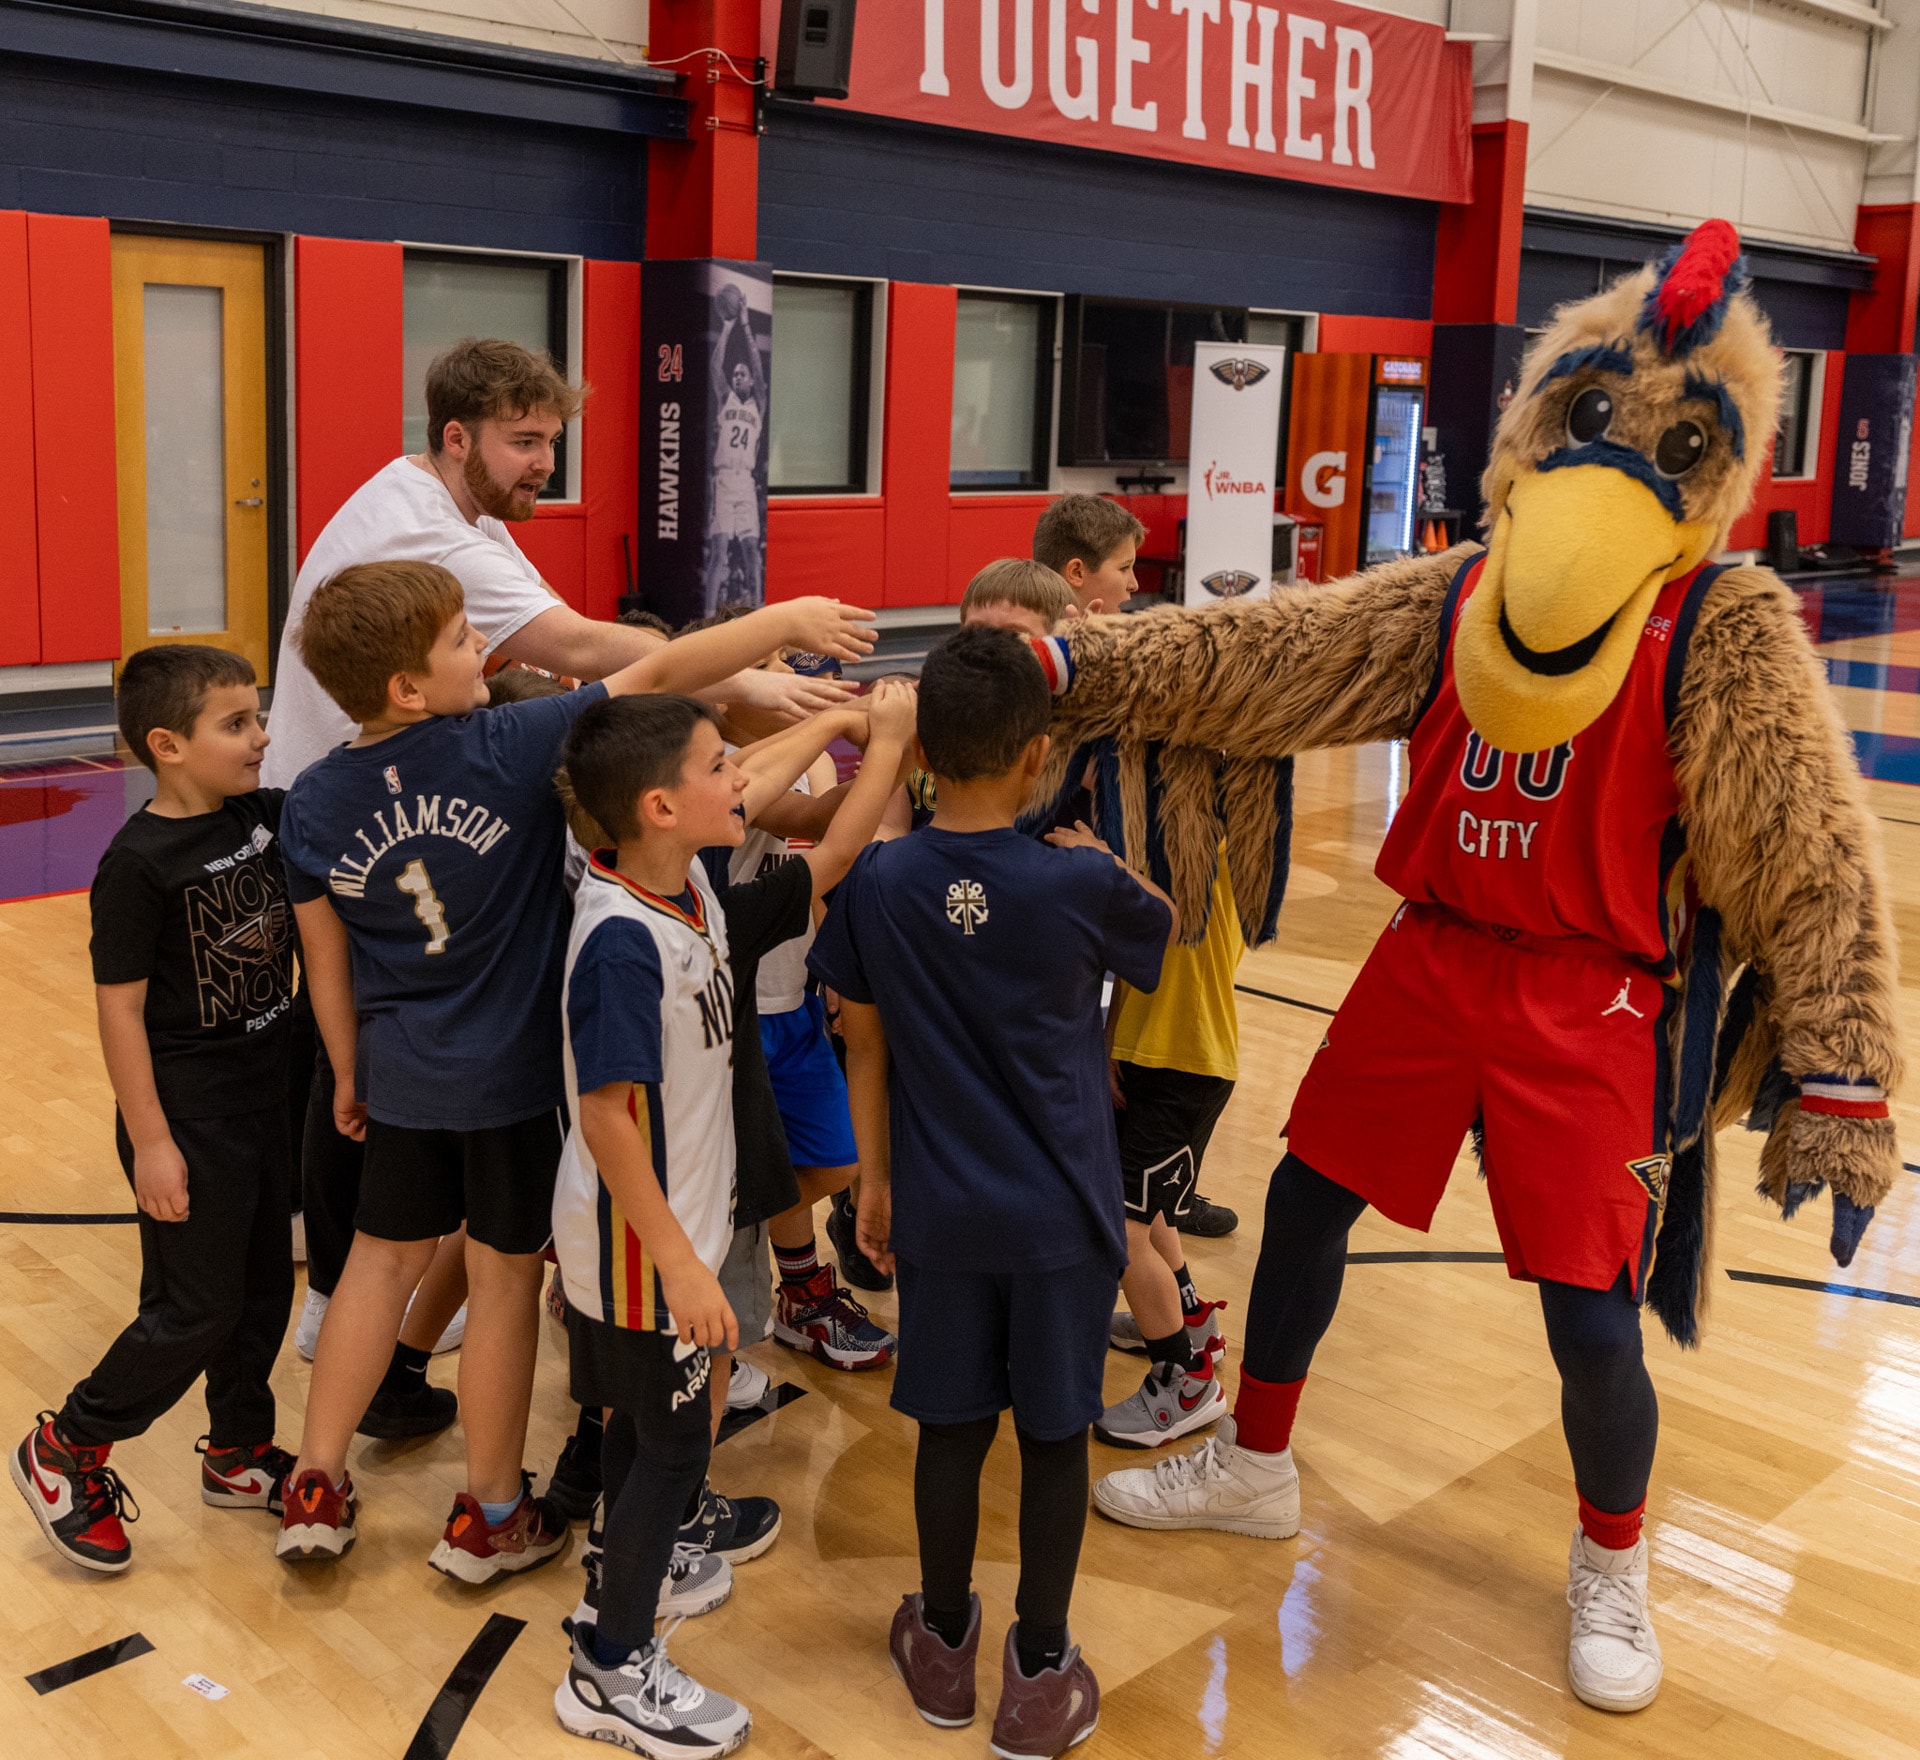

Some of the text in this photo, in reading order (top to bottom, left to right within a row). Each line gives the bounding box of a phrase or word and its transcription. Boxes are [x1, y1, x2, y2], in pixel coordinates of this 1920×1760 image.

[919, 0, 1376, 169] TOGETHER
[658, 344, 683, 382] 24
[730, 425, 749, 450] 24
[657, 402, 681, 540] HAWKINS
[1215, 481, 1266, 494] WNBA
[1216, 471, 1232, 481] JR.
[1301, 451, 1347, 508] G
[1849, 441, 1871, 492] JONES
[329, 795, 511, 898] WILLIAMSON
[1457, 810, 1539, 859] CITY
[203, 856, 236, 873] NEW
[395, 858, 451, 954] 1
